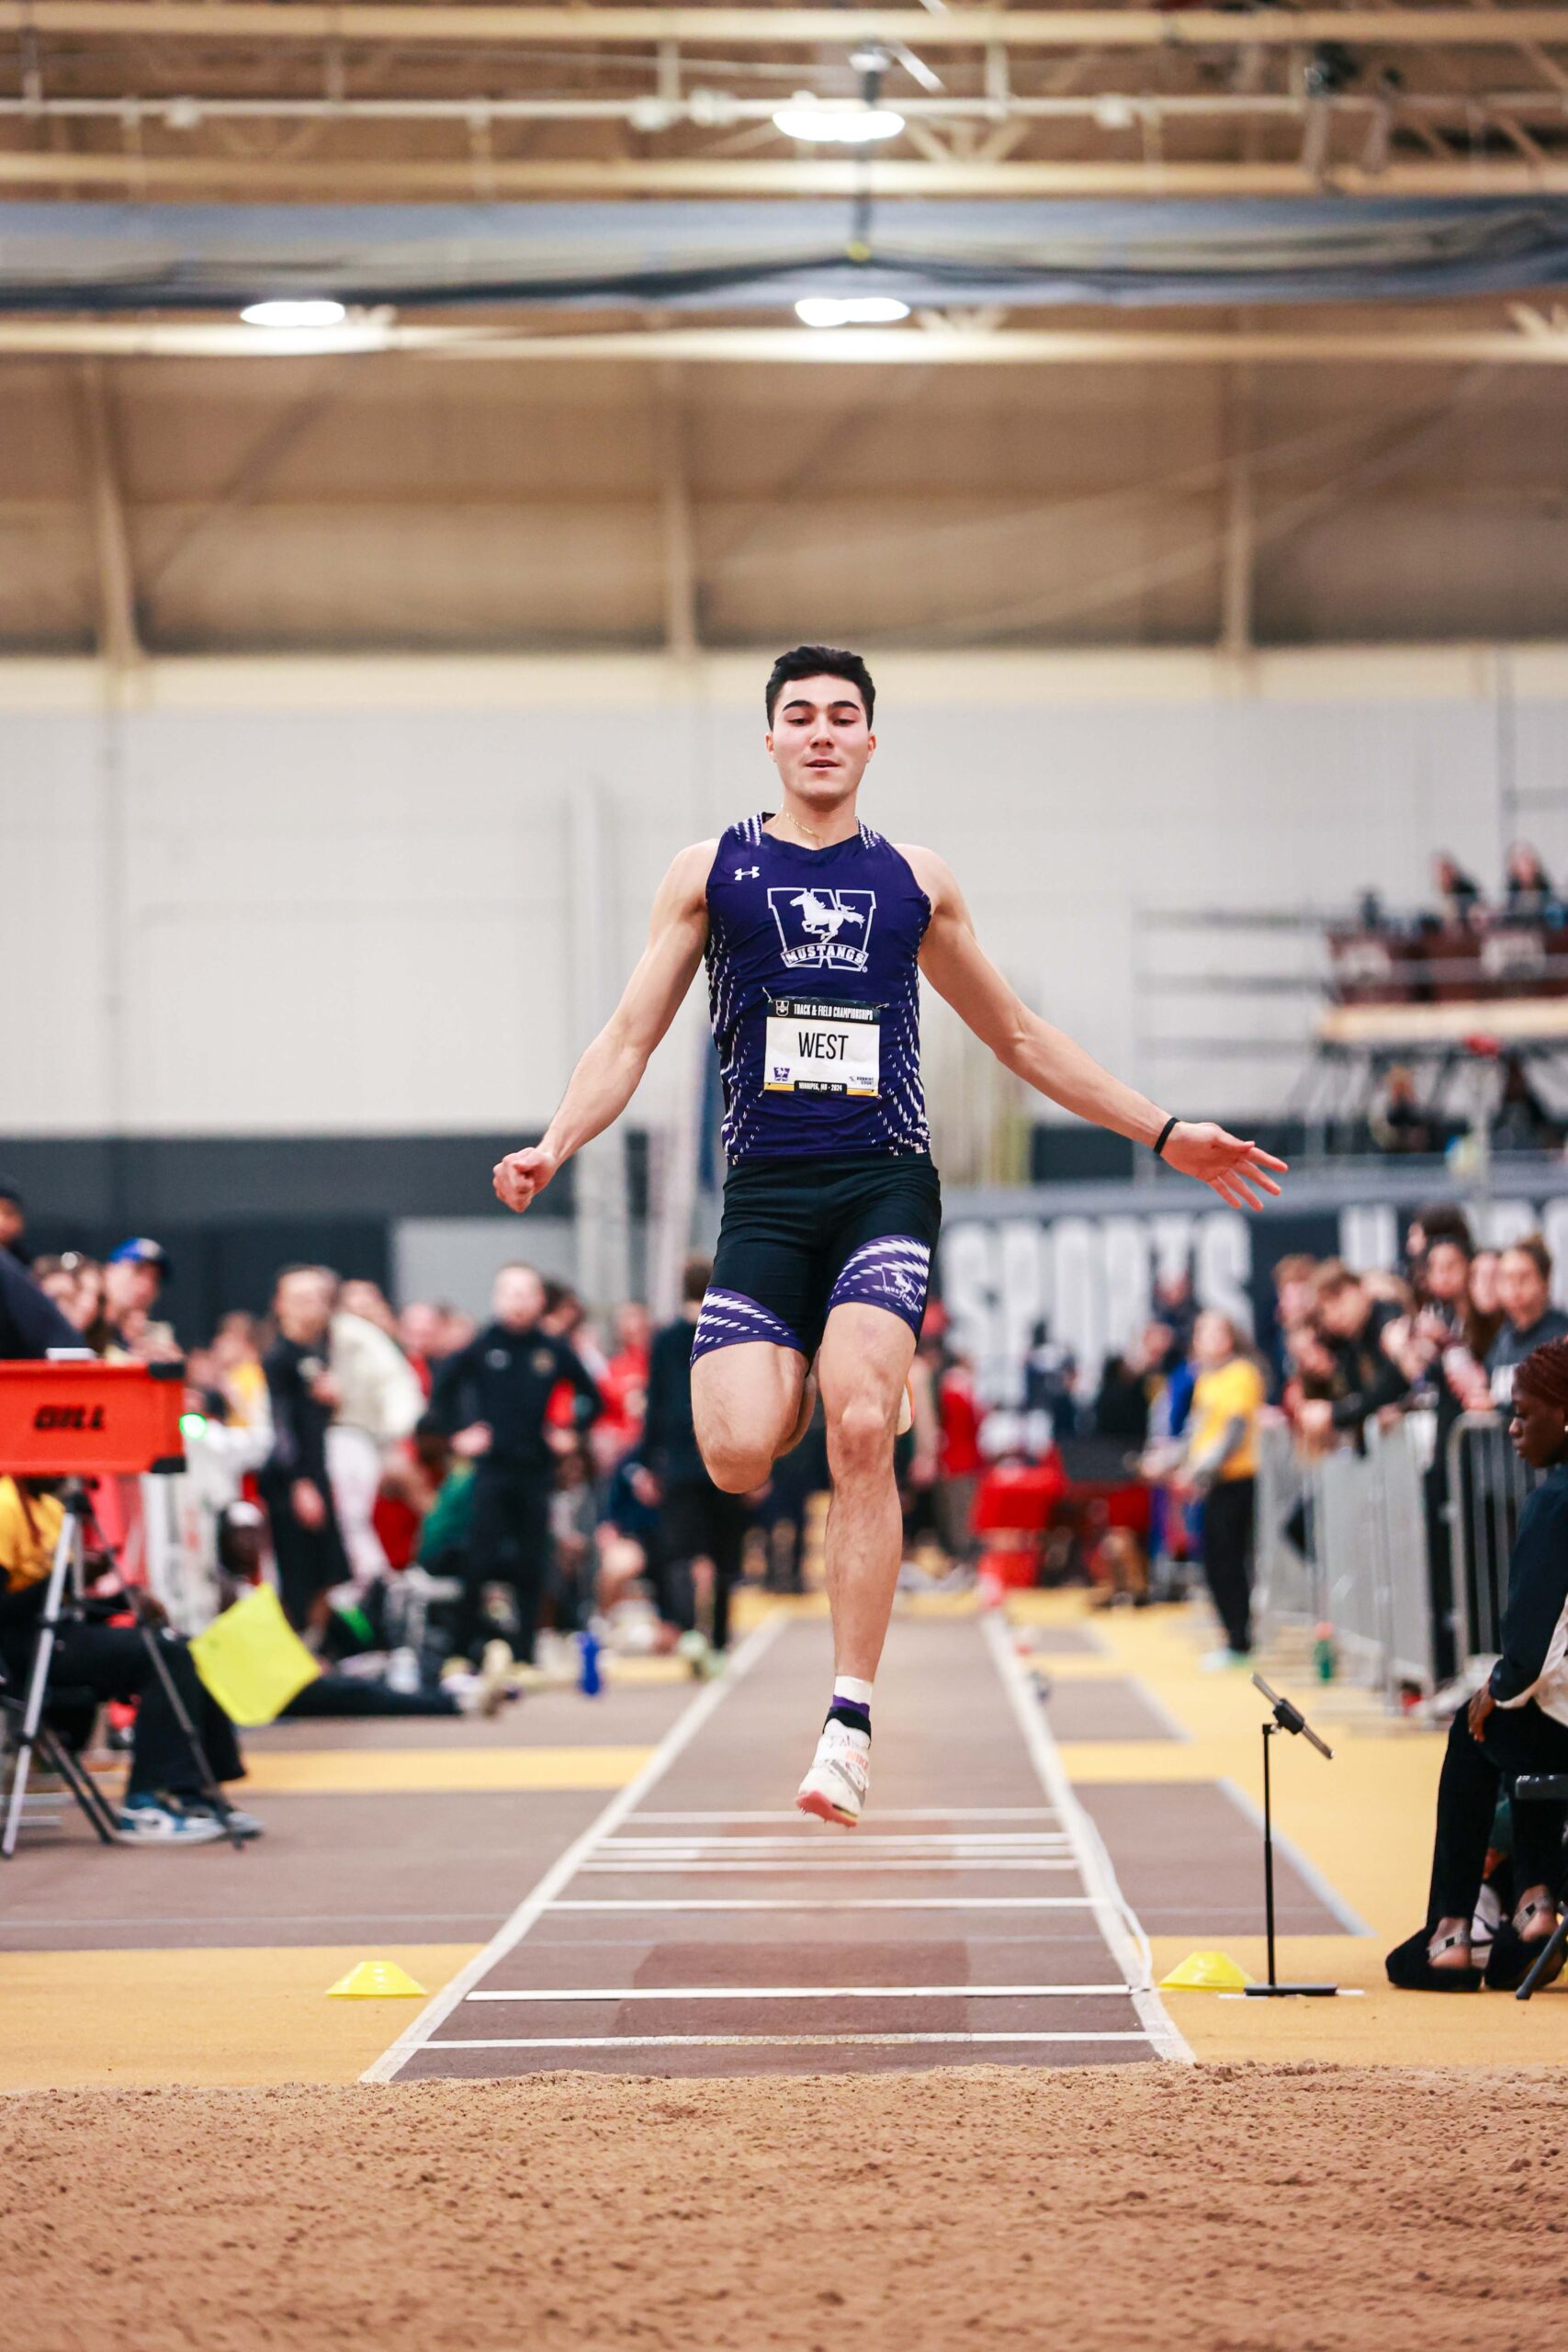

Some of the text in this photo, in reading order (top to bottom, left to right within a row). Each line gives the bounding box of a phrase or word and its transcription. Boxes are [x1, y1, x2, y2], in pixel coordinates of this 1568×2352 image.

[785, 944, 865, 964] MUSTANGS
[794, 1003, 811, 1015] TRACK
[818, 1005, 833, 1017] FIELD
[833, 1006, 874, 1021] CHAMPIONSHIPS
[798, 1031, 849, 1061] WEST
